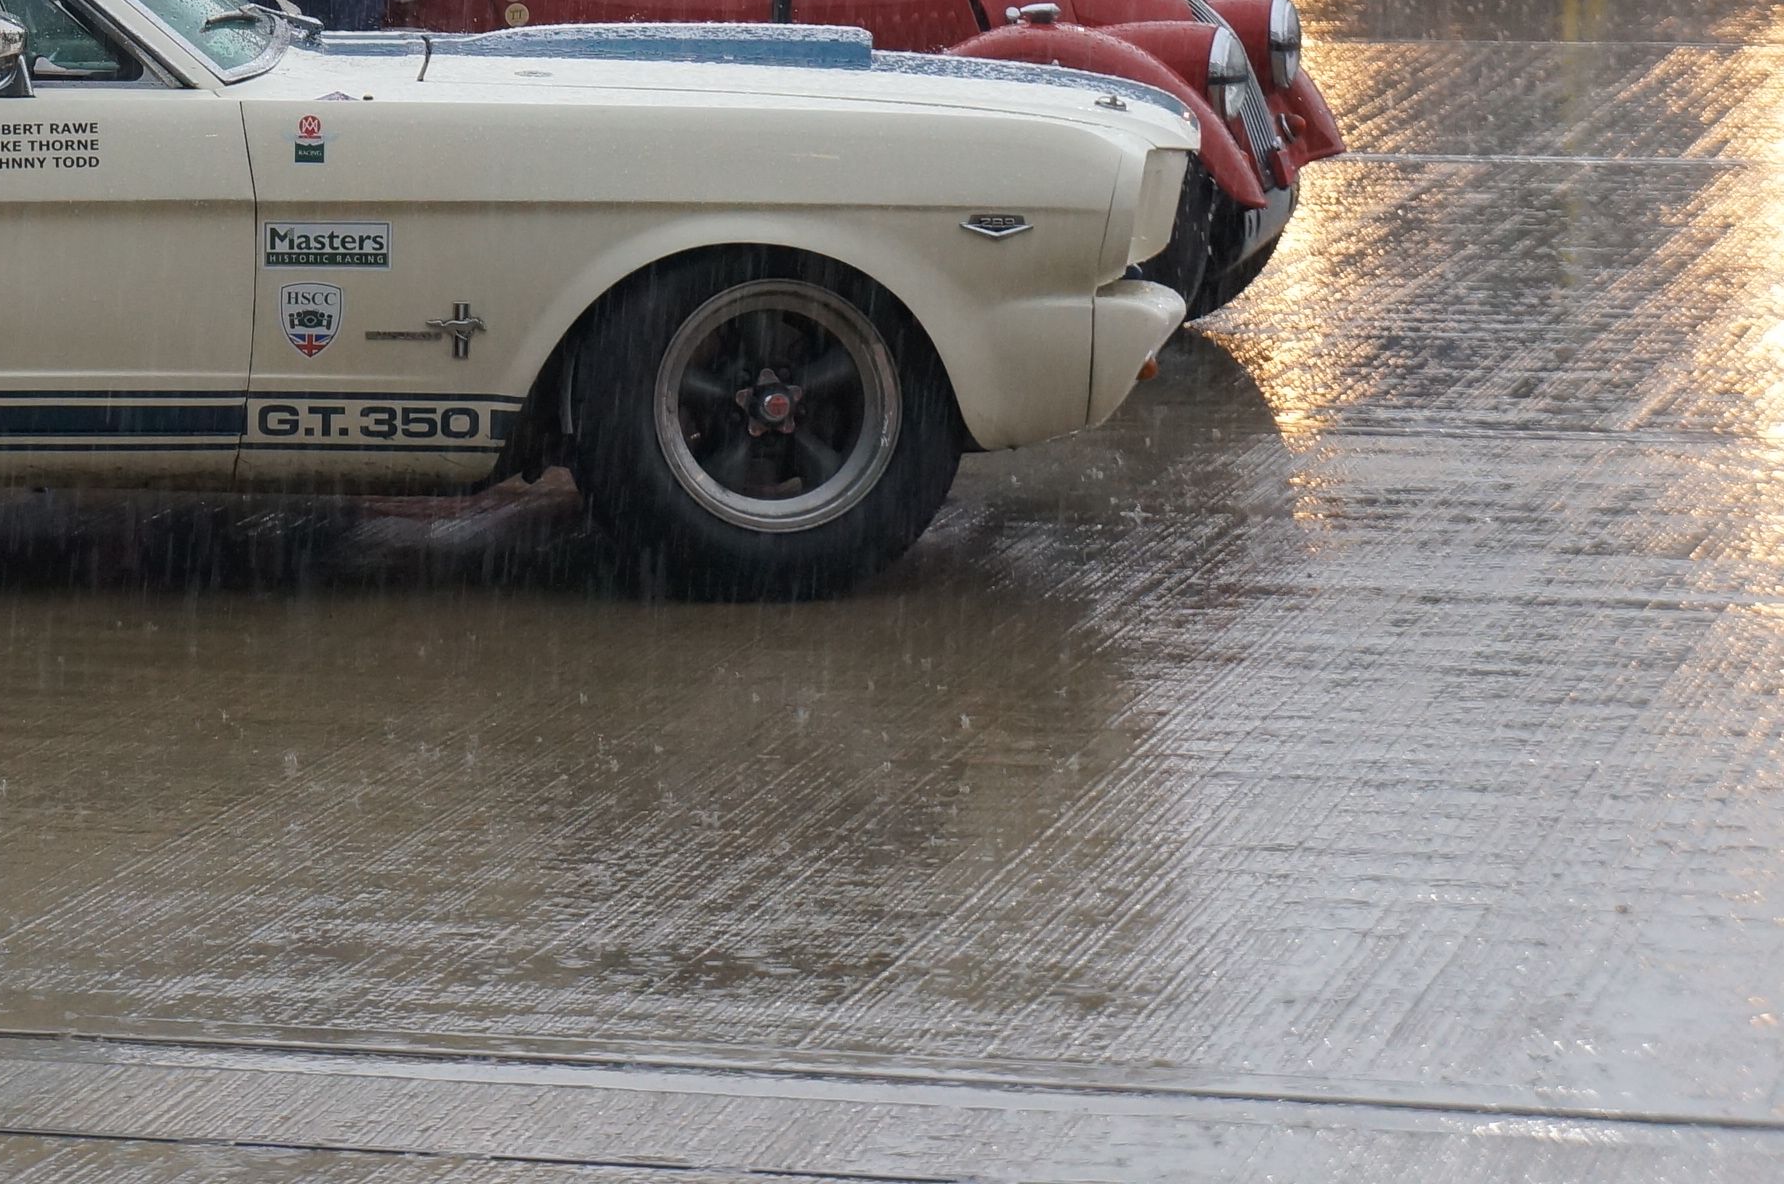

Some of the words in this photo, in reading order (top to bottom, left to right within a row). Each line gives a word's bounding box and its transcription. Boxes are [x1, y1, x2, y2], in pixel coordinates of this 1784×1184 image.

[49, 122, 99, 134] RAWE
[27, 139, 100, 151] THORNE
[52, 156, 100, 168] TODD
[269, 227, 385, 251] Masters
[269, 254, 329, 263] HISTORIC
[336, 254, 384, 264] RACING
[286, 291, 337, 306] HSCC
